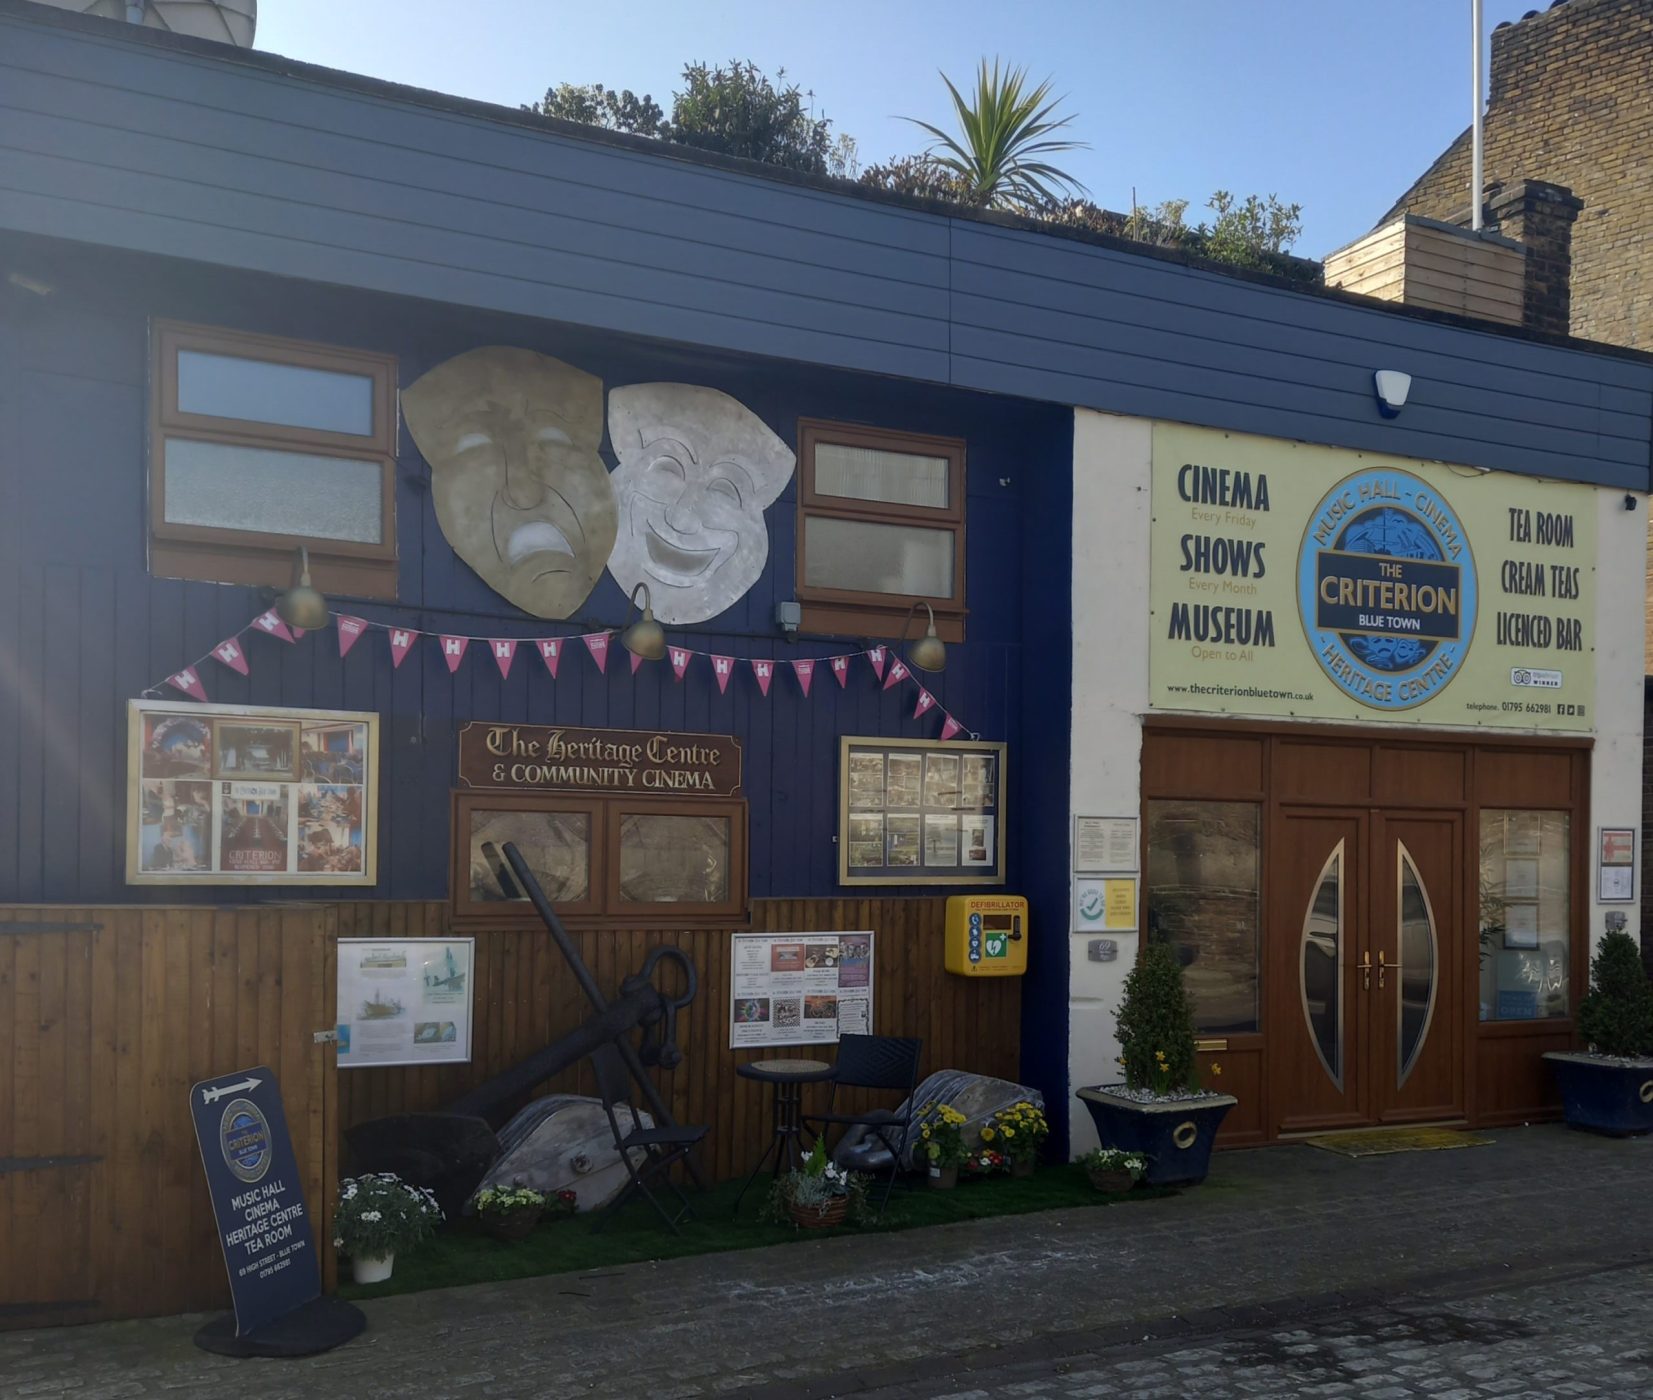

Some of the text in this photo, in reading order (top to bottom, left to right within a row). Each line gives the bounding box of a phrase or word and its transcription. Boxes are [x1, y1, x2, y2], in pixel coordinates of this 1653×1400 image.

[1178, 464, 1270, 512] CINEMA
[1191, 507, 1256, 529] Every Friday
[1313, 491, 1357, 546] MUSIC
[1359, 479, 1401, 503] HALL
[1414, 492, 1463, 560] CINEMA
[1509, 507, 1574, 548] TEA ROOM
[1180, 534, 1266, 578] SHOWS
[1379, 563, 1403, 578] THE
[1189, 577, 1257, 595] Every Month
[1320, 576, 1456, 615] CRITERION
[1501, 559, 1579, 600] CREAM TEAS
[1168, 602, 1275, 647] MUSEUM
[1358, 614, 1420, 630] BLUE TOWN
[1497, 612, 1582, 651] LICENCED BAR
[1191, 646, 1254, 661] Open to All
[1322, 644, 1392, 702] HERITAGE
[1398, 653, 1454, 701] CENTRE
[1167, 683, 1314, 700] www.thecriterionbluetown.co.uk
[1502, 702, 1523, 712] 01795
[1525, 703, 1551, 713] 662981
[486, 726, 720, 768] The Heritage Centre
[492, 764, 715, 790] & COMMUNITY CINEMA
[971, 901, 1024, 909] DEFIBRILLATOR
[229, 1130, 265, 1150] CRITERION
[231, 1179, 286, 1211] MUSIC HALL
[245, 1198, 280, 1221] CINEMA
[226, 1203, 303, 1247] HERITAGE CENTRE
[244, 1224, 292, 1255] TEA ROOM
[246, 1262, 259, 1273] HIGH
[259, 1253, 276, 1267] STREET
[279, 1247, 291, 1257] BLUE
[291, 1240, 305, 1252] TOWN
